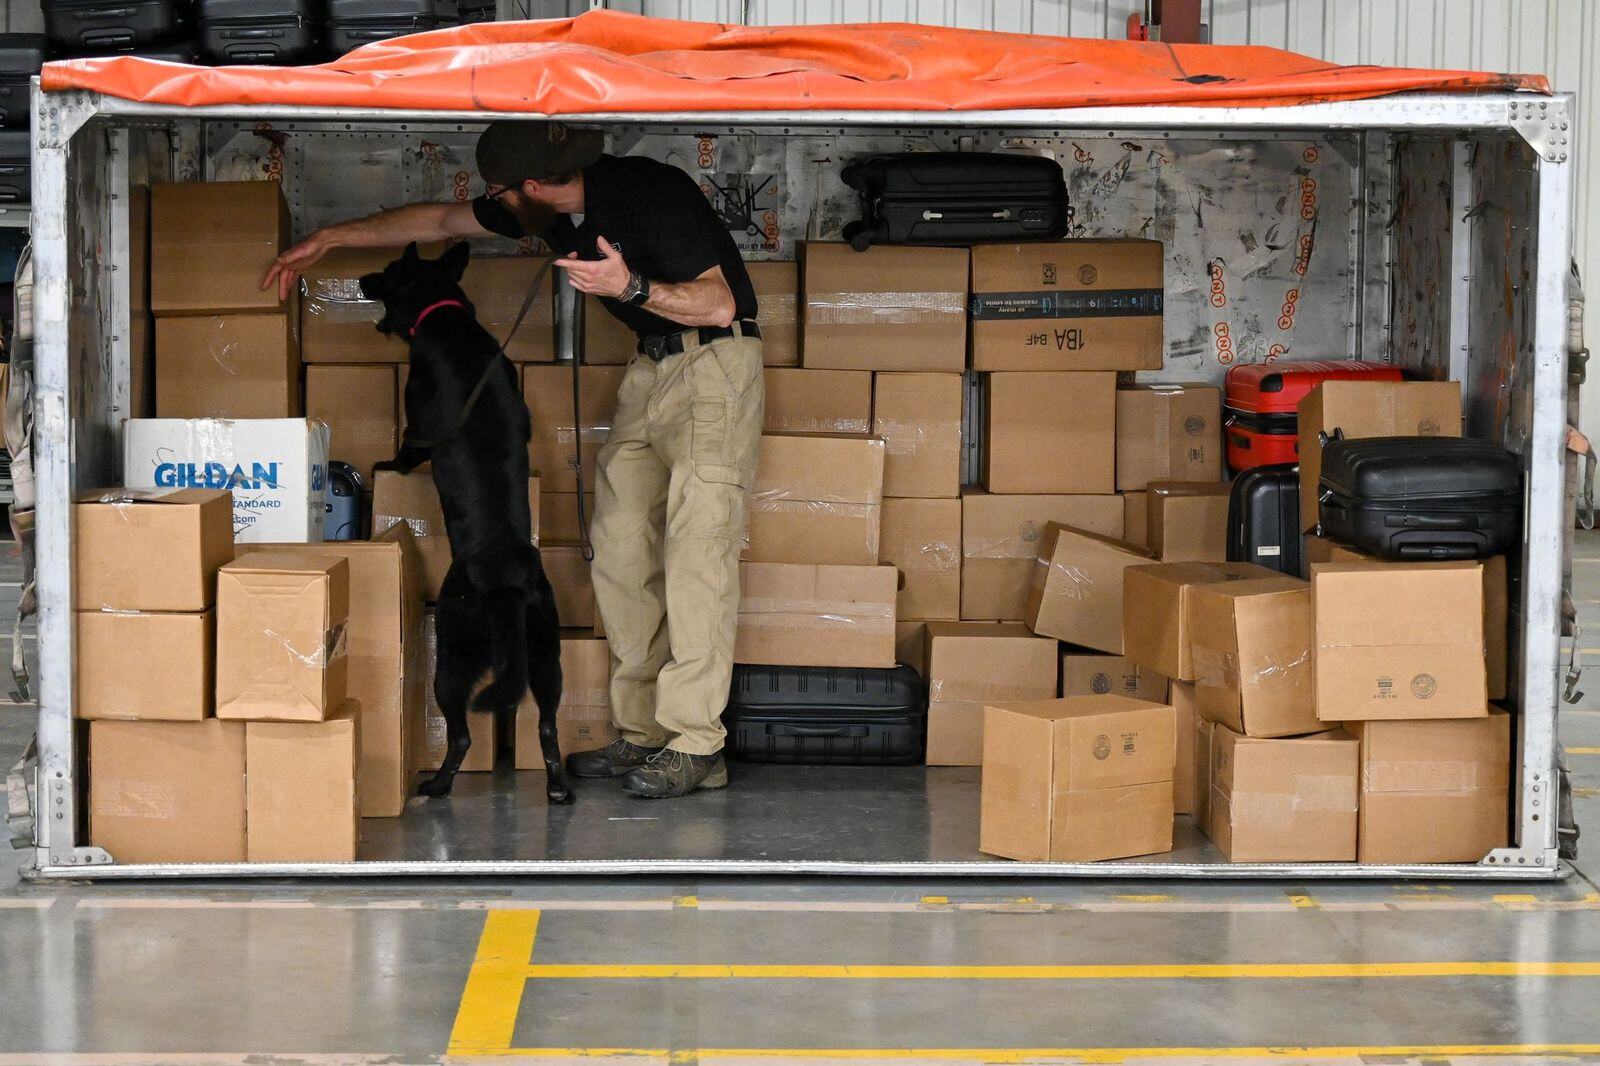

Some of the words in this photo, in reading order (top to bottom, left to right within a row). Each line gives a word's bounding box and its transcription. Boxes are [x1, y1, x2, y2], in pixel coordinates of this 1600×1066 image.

[1302, 178, 1315, 220] TNT
[1212, 266, 1225, 307] TNT
[1025, 334, 1048, 345] B4F
[1054, 329, 1085, 350] 1BA
[1215, 322, 1233, 365] TNT
[154, 462, 278, 489] GILDAN
[231, 500, 281, 508] TANDARD
